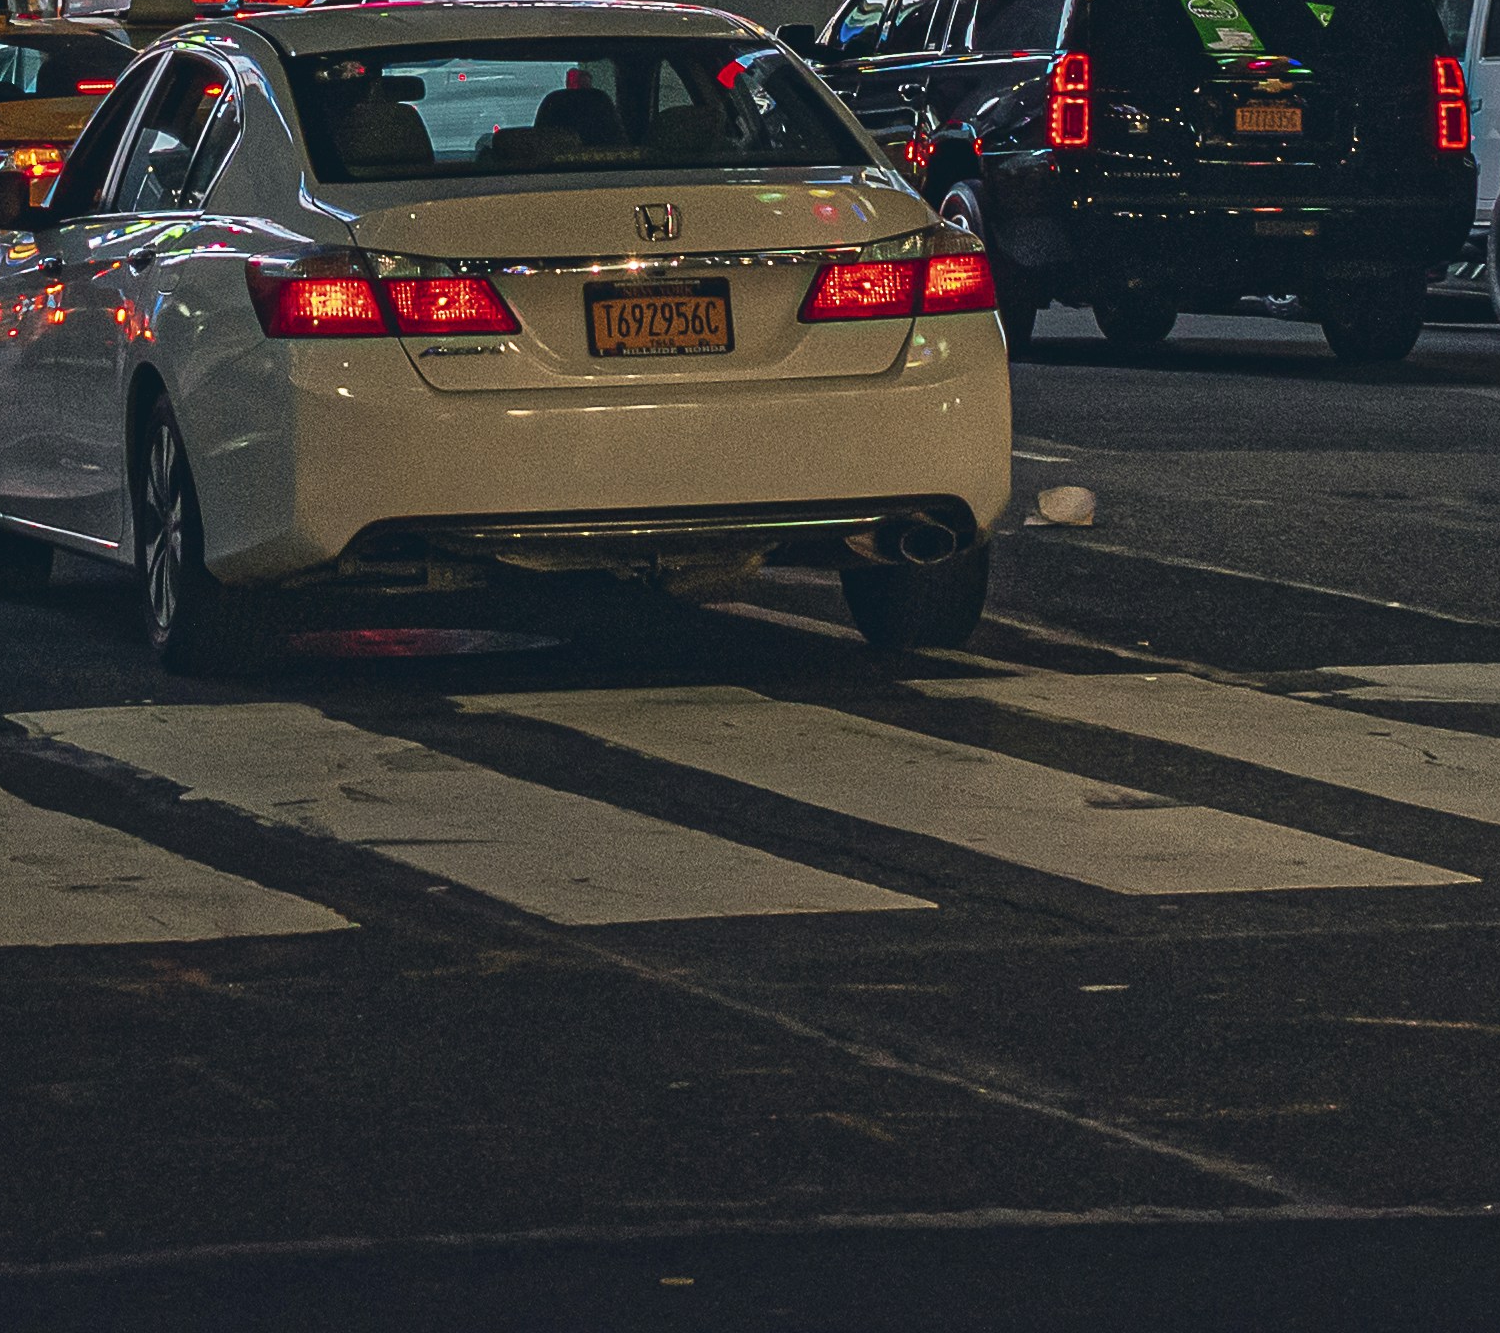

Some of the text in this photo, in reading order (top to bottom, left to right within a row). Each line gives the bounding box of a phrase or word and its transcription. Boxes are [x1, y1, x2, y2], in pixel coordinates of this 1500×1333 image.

[601, 301, 720, 339] T692956C
[623, 345, 727, 356] HILLSIDE HONDA
